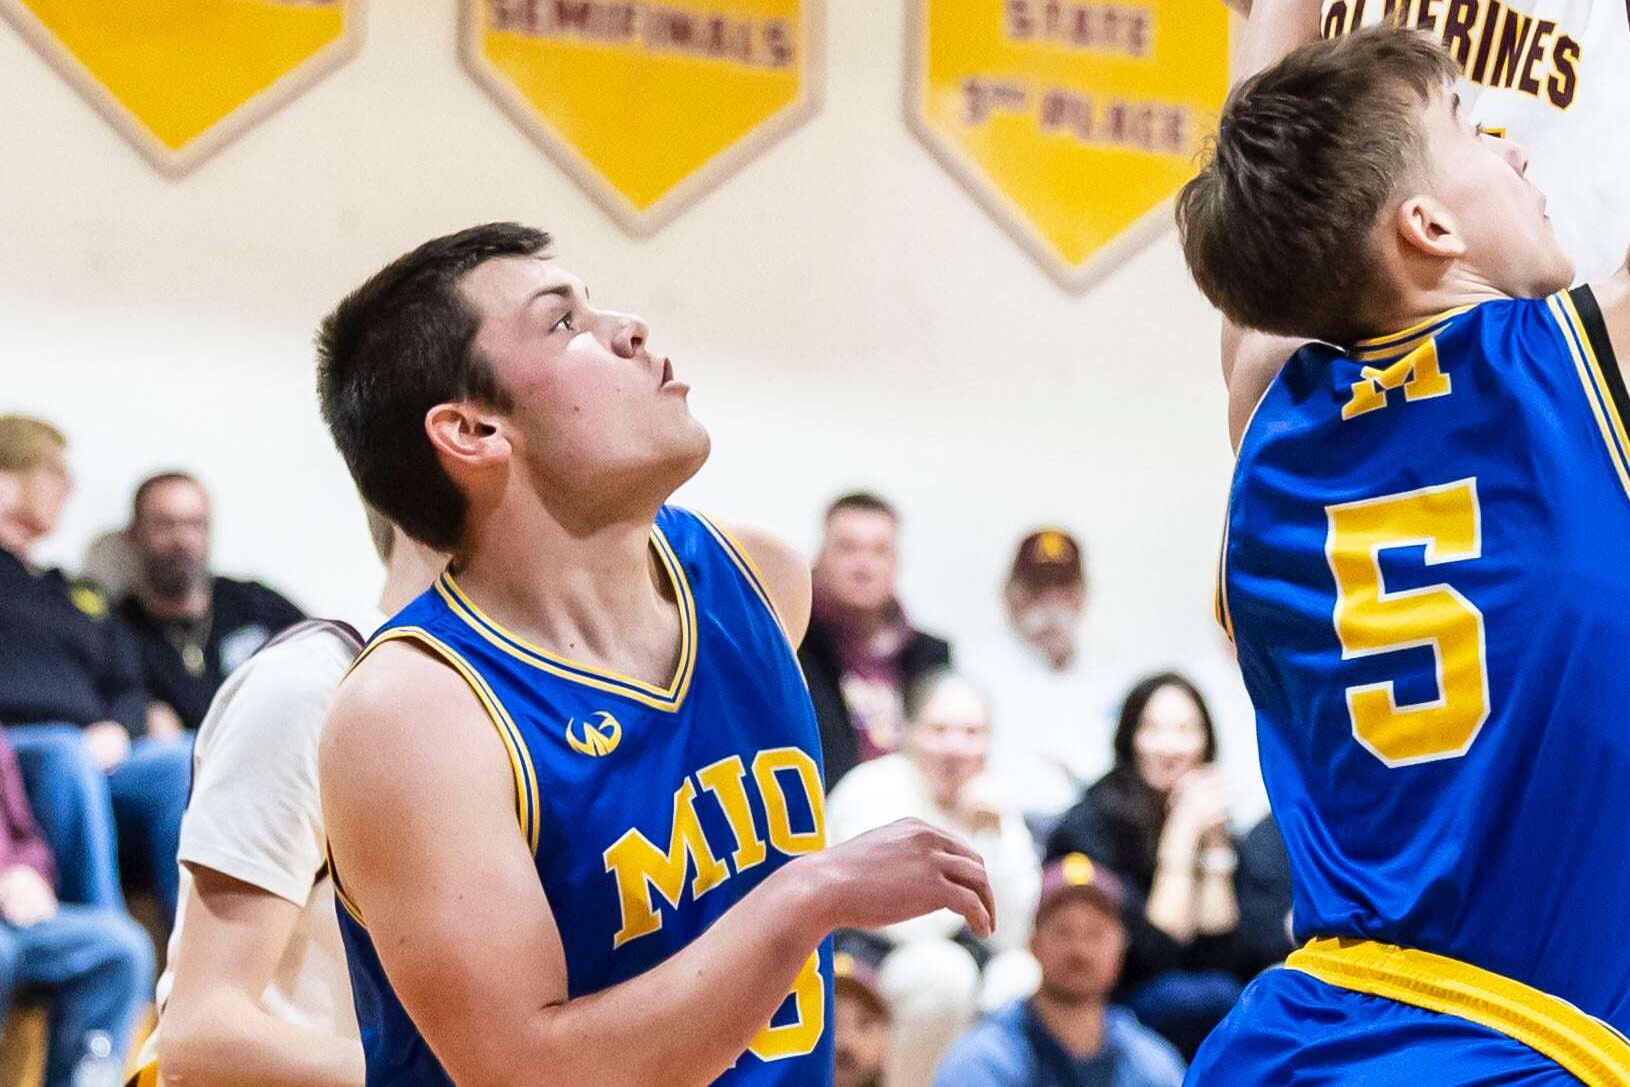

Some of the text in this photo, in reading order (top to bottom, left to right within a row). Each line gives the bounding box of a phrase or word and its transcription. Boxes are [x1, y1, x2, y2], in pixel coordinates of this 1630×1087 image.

[1040, 86, 1194, 157] PLACE
[1342, 336, 1452, 421] M
[1324, 476, 1491, 769] 5
[602, 745, 827, 950] MIO
